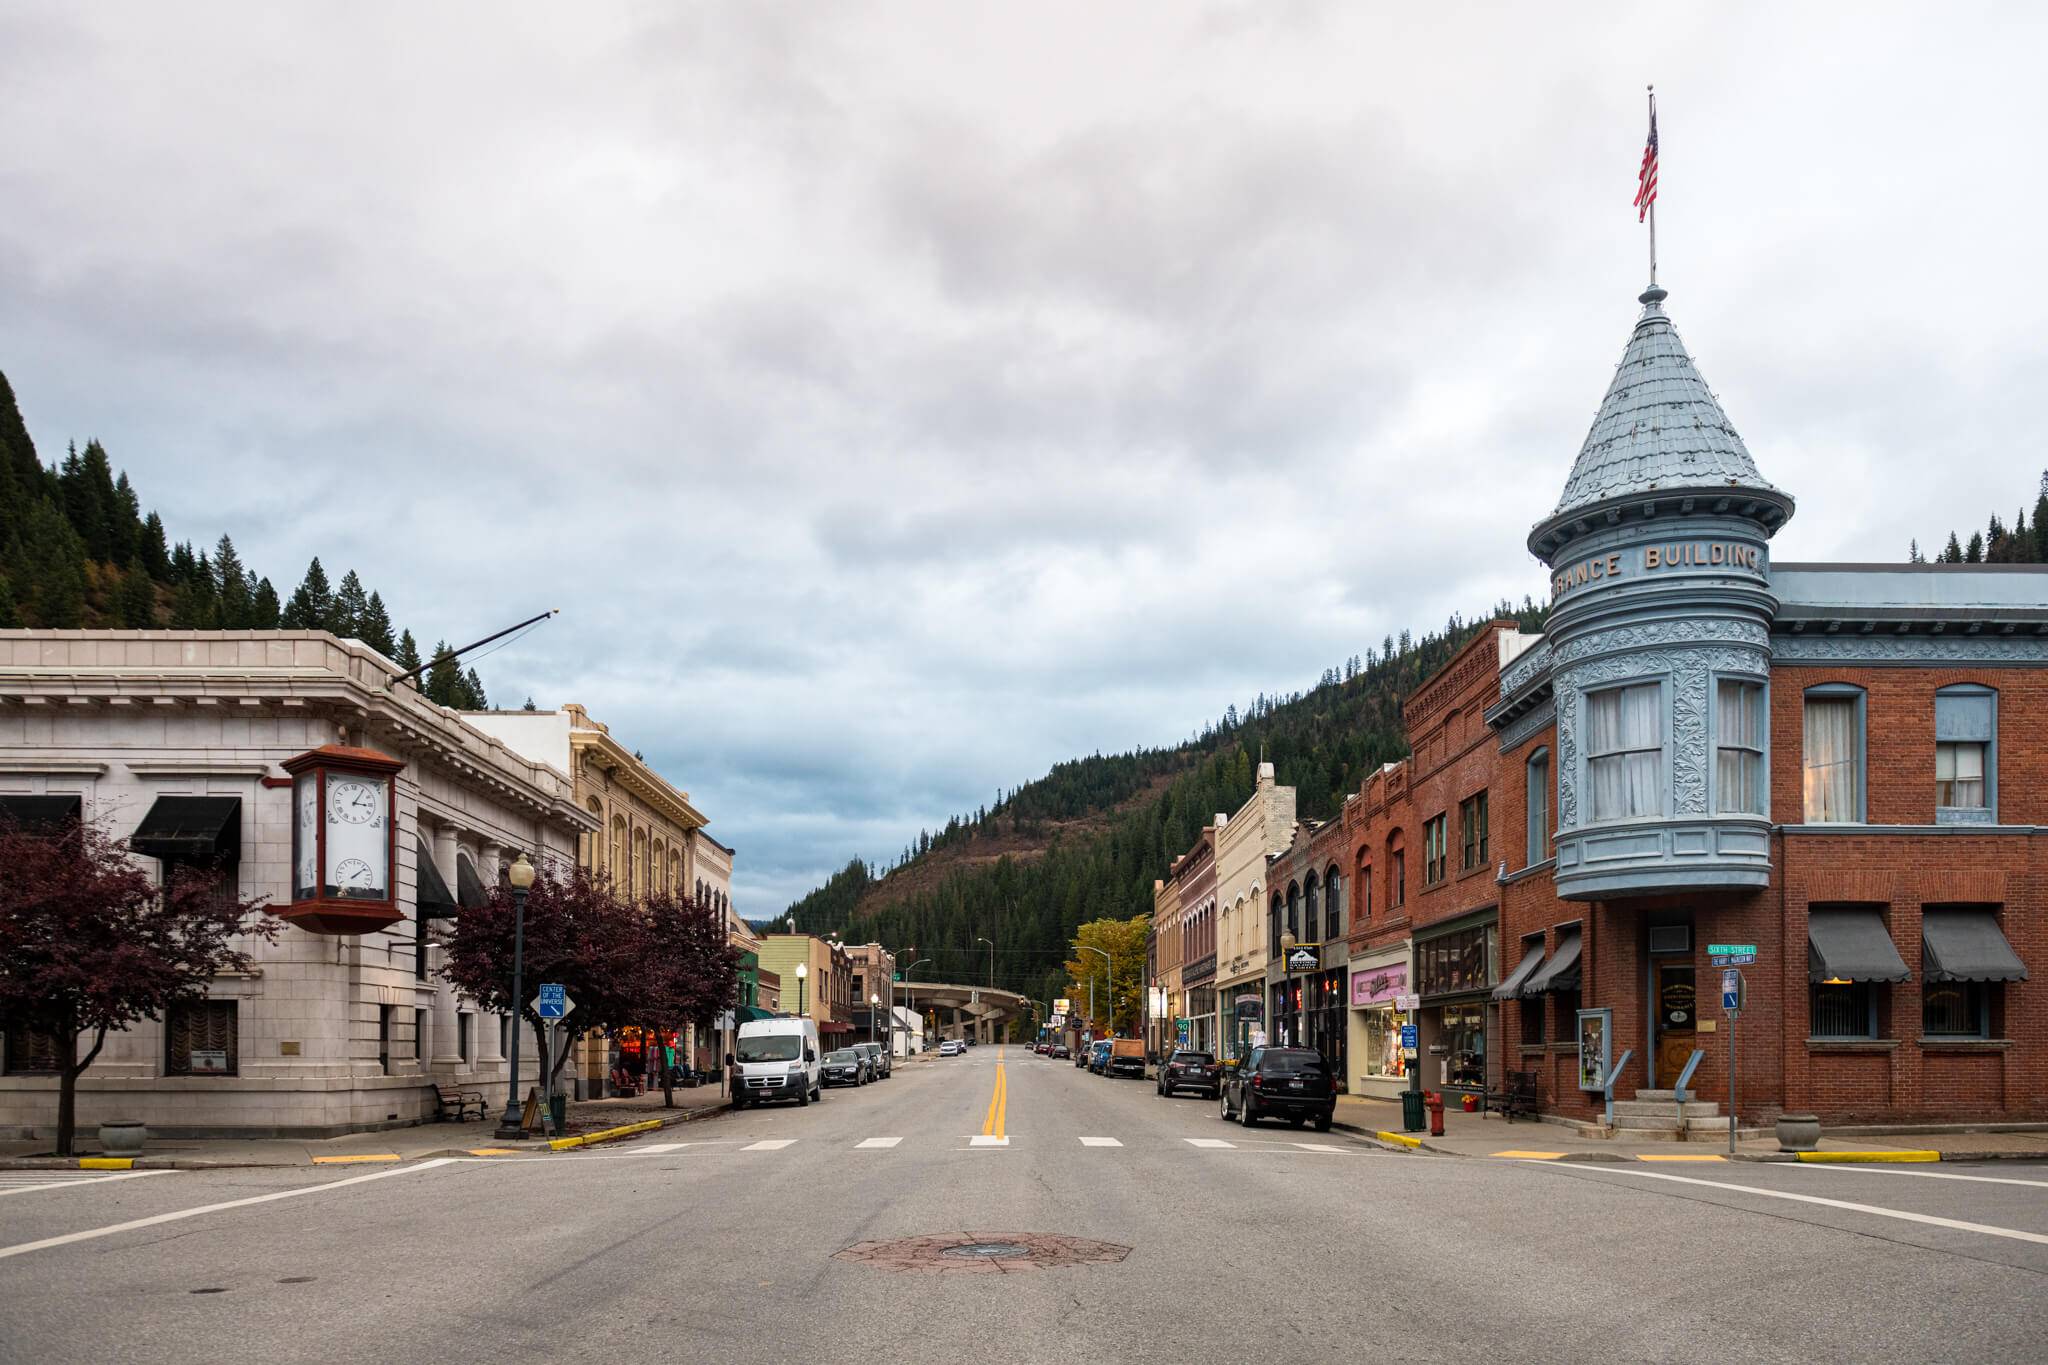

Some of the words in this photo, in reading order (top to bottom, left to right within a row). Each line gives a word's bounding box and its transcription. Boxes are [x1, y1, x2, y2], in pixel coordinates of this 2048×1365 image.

[1645, 543, 1758, 569] BUILDING
[1711, 946, 1728, 954] SIXTH
[1731, 946, 1754, 955] STREET
[1178, 1023, 1188, 1031] 90
